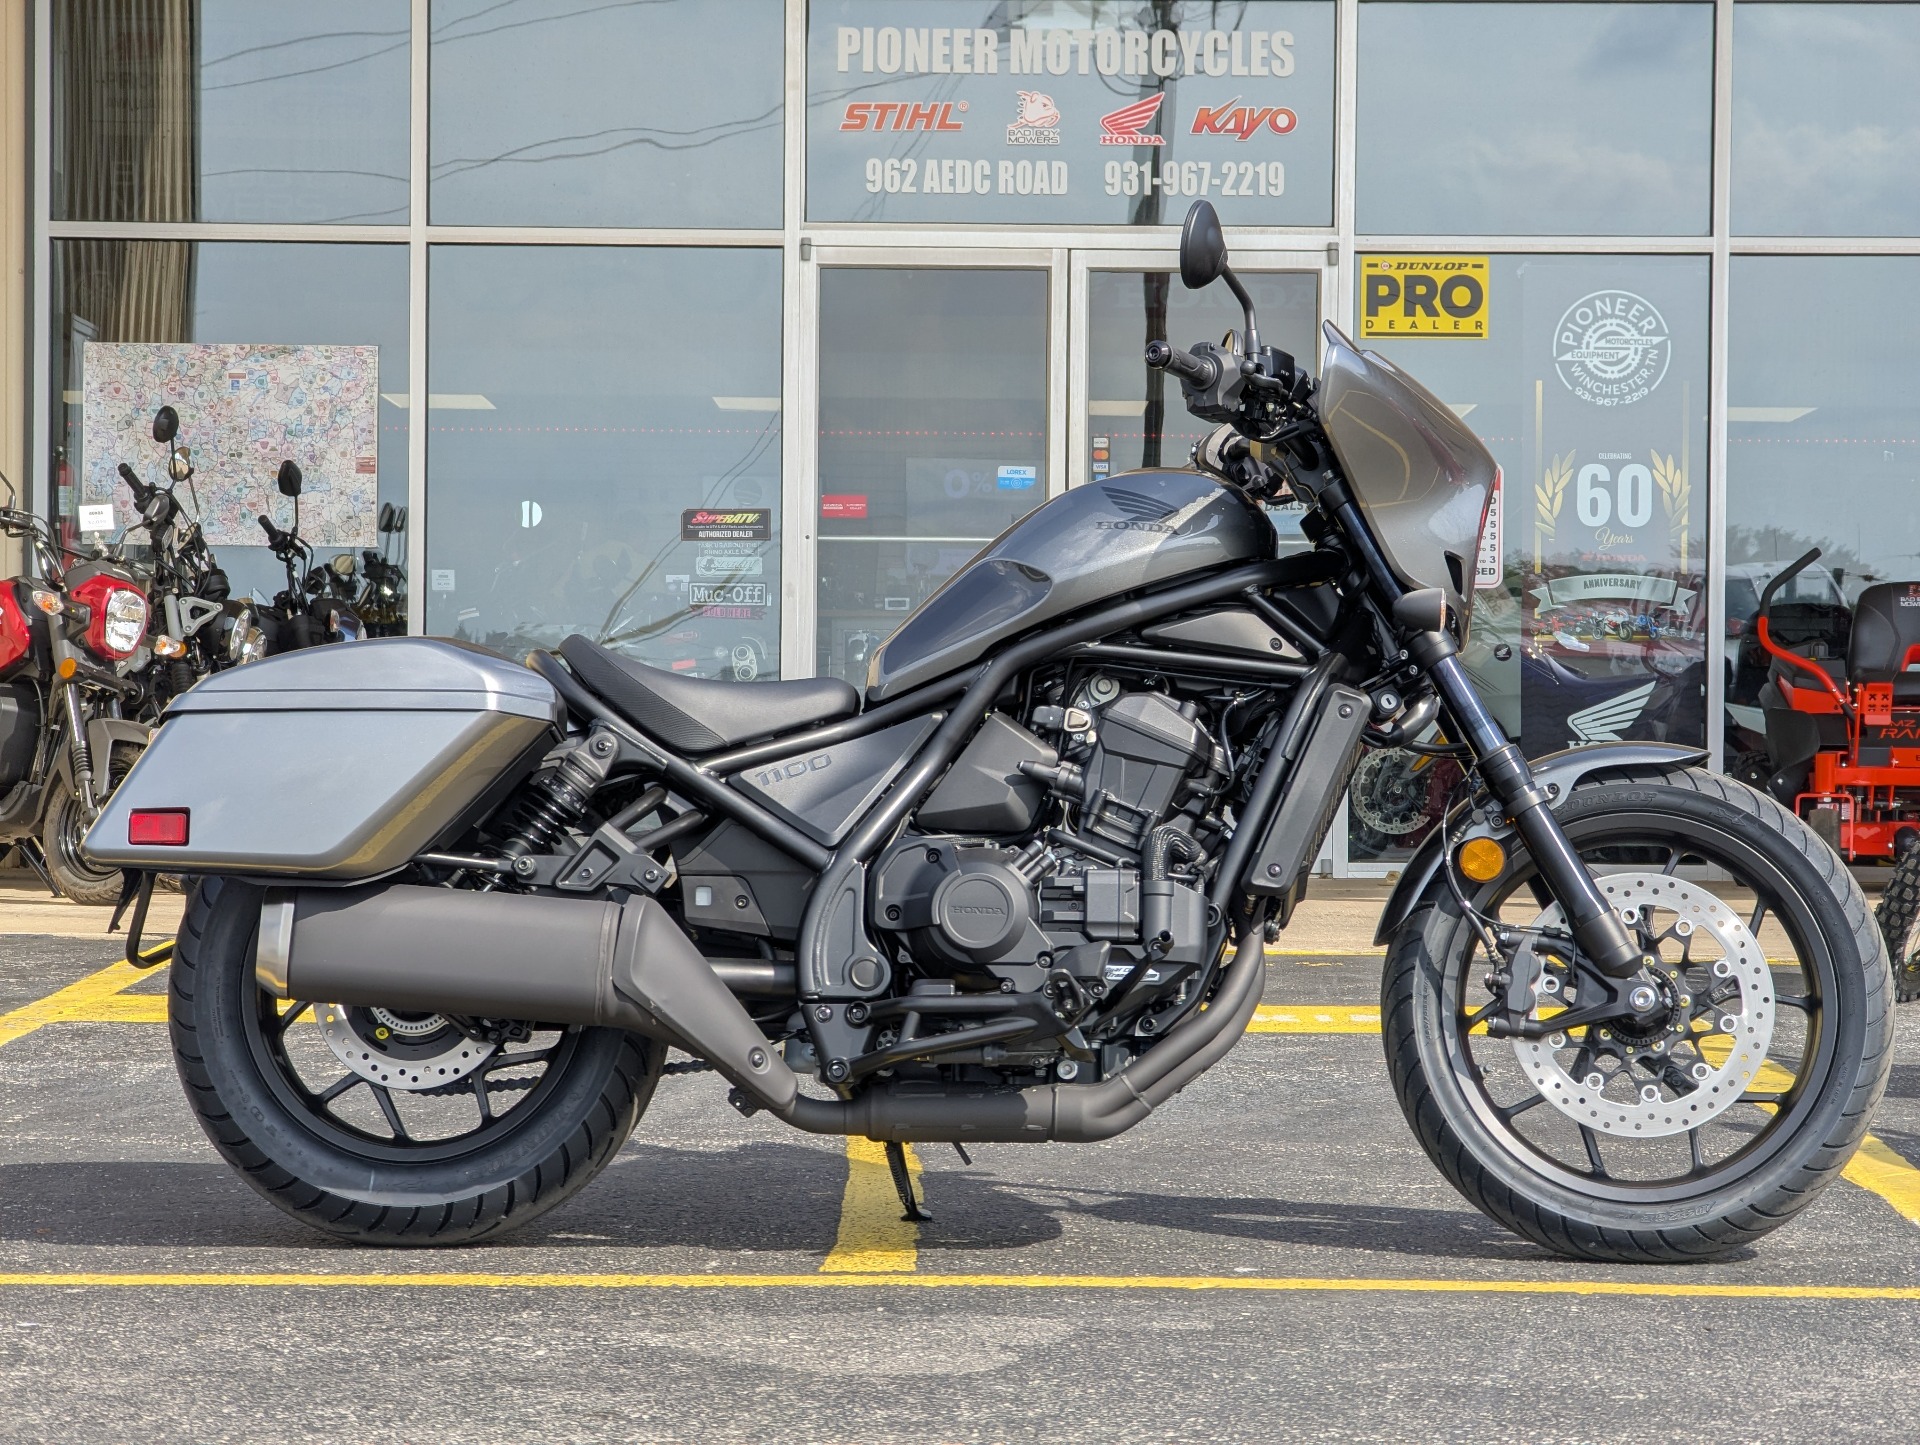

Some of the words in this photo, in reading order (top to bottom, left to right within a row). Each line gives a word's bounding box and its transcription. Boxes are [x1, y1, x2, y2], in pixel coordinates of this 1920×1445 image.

[837, 26, 998, 74] PIONEER
[1009, 29, 1295, 77] MOTORCYCLES
[839, 102, 963, 131] STIHL
[1190, 95, 1298, 141] KAYO
[1100, 135, 1166, 145] HONDA
[865, 159, 916, 193] 962
[923, 160, 991, 194] AEDC
[998, 160, 1068, 195] ROAD
[1104, 160, 1285, 196] 931-967-2219
[1394, 262, 1469, 270] DUNLOP
[1366, 274, 1483, 318] PRO
[1366, 320, 1483, 329] DEALER
[1561, 297, 1657, 346] PIONEER
[1605, 338, 1653, 346] MOTORCYCLES
[1571, 350, 1620, 359] EQUIPMENT
[1574, 386, 1649, 406] 931-967-2219
[1598, 452, 1632, 460] CELEBRATING
[1576, 463, 1653, 528] 60
[698, 530, 732, 538] AUTHORIZED
[732, 530, 753, 538] DEALER
[1095, 521, 1181, 535] HONDA
[1595, 526, 1634, 550] Years
[1583, 577, 1642, 590] ANNIVERSARY
[693, 587, 762, 603] Muc-Off
[754, 753, 832, 786] 1100
[951, 906, 1006, 916] HONDA
